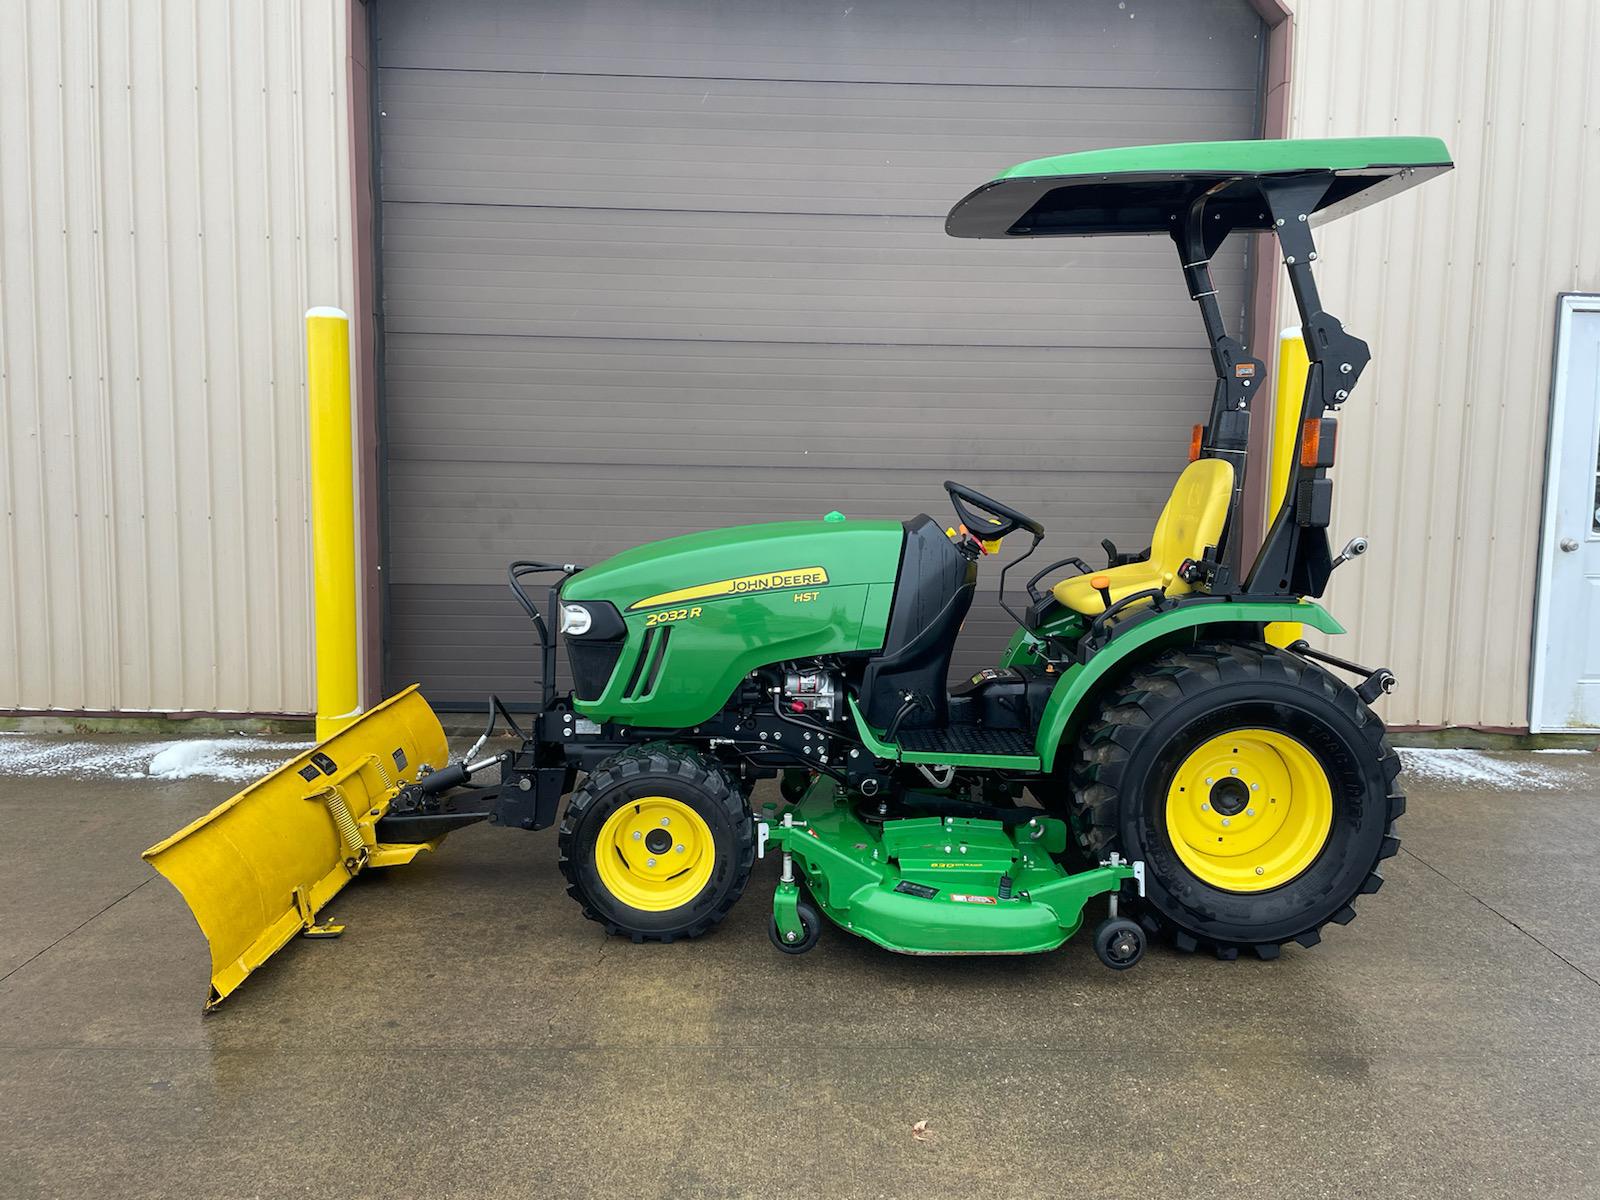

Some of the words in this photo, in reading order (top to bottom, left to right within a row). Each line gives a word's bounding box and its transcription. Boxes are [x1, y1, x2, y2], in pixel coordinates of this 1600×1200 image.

[728, 578, 769, 593] JOHN
[772, 573, 821, 587] DEERE
[793, 592, 819, 603] HST
